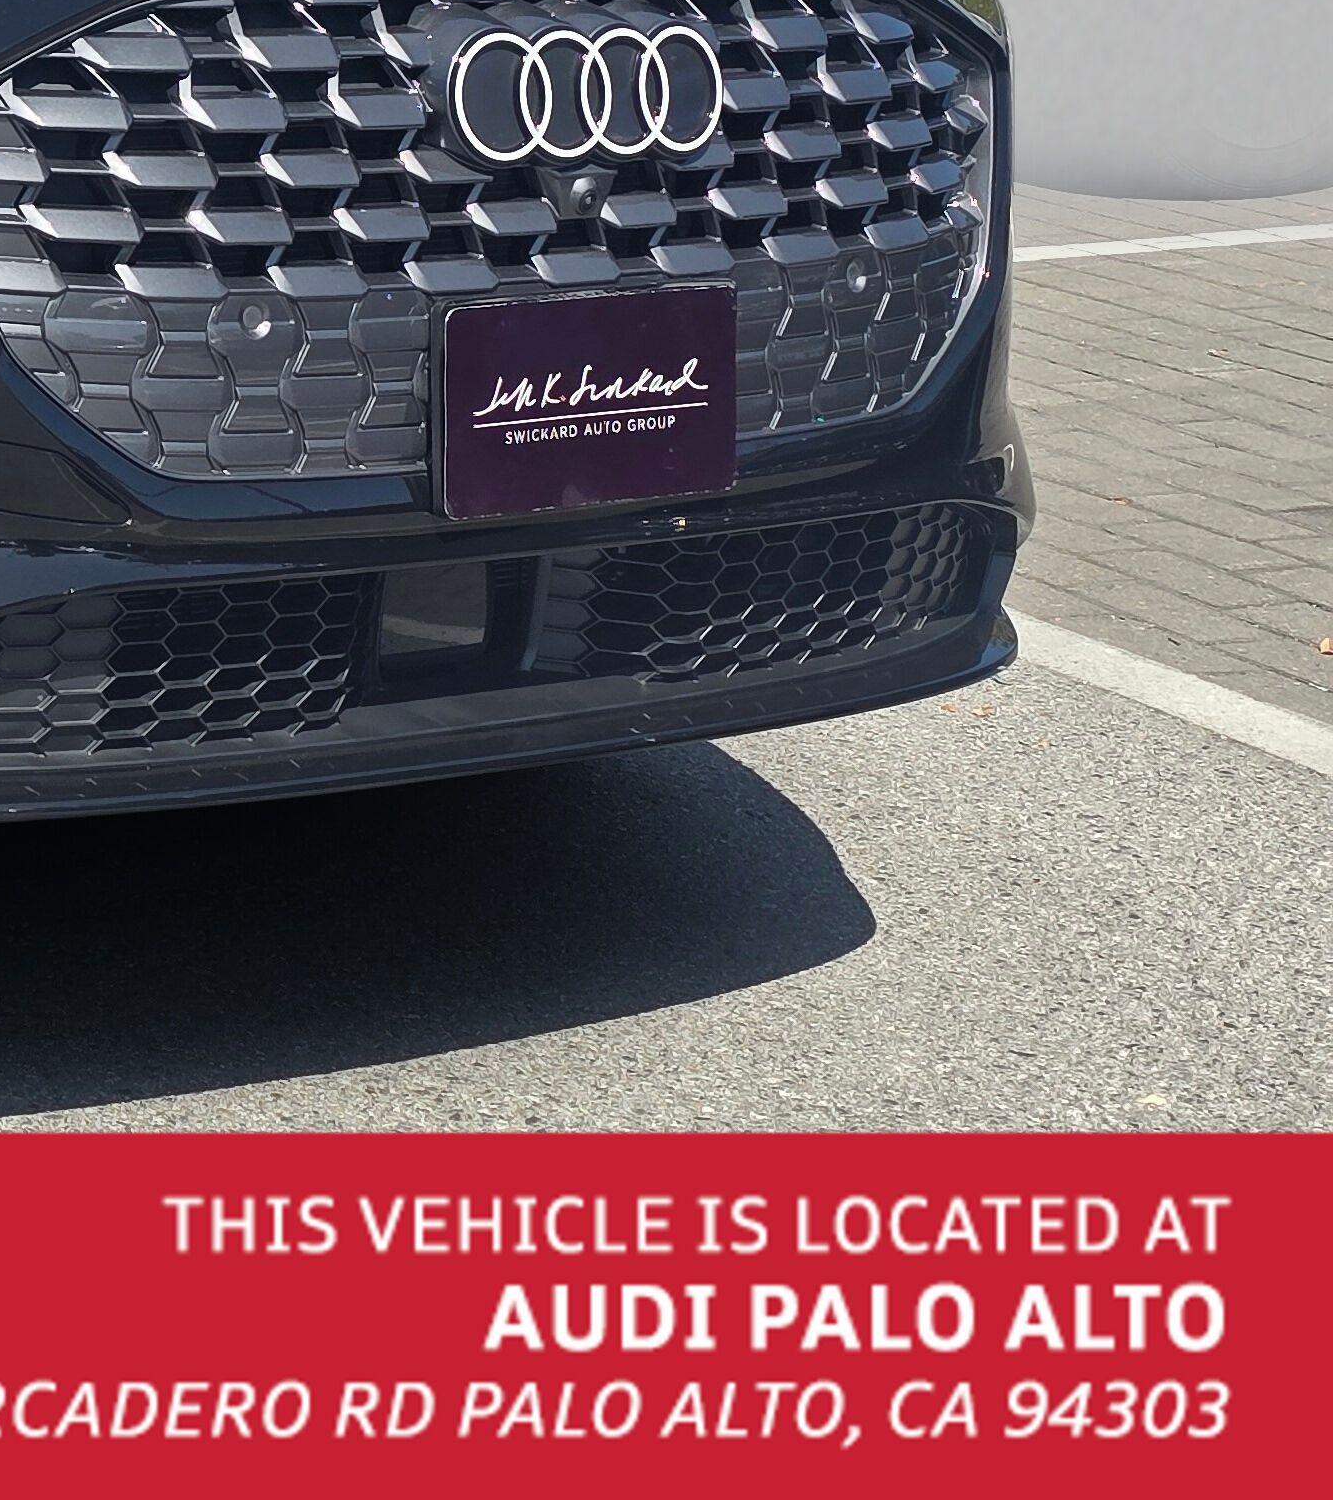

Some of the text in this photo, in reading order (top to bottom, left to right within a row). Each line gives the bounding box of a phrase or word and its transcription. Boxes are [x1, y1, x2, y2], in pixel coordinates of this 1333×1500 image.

[504, 415, 677, 446] SWICKARD AUTO GROUP
